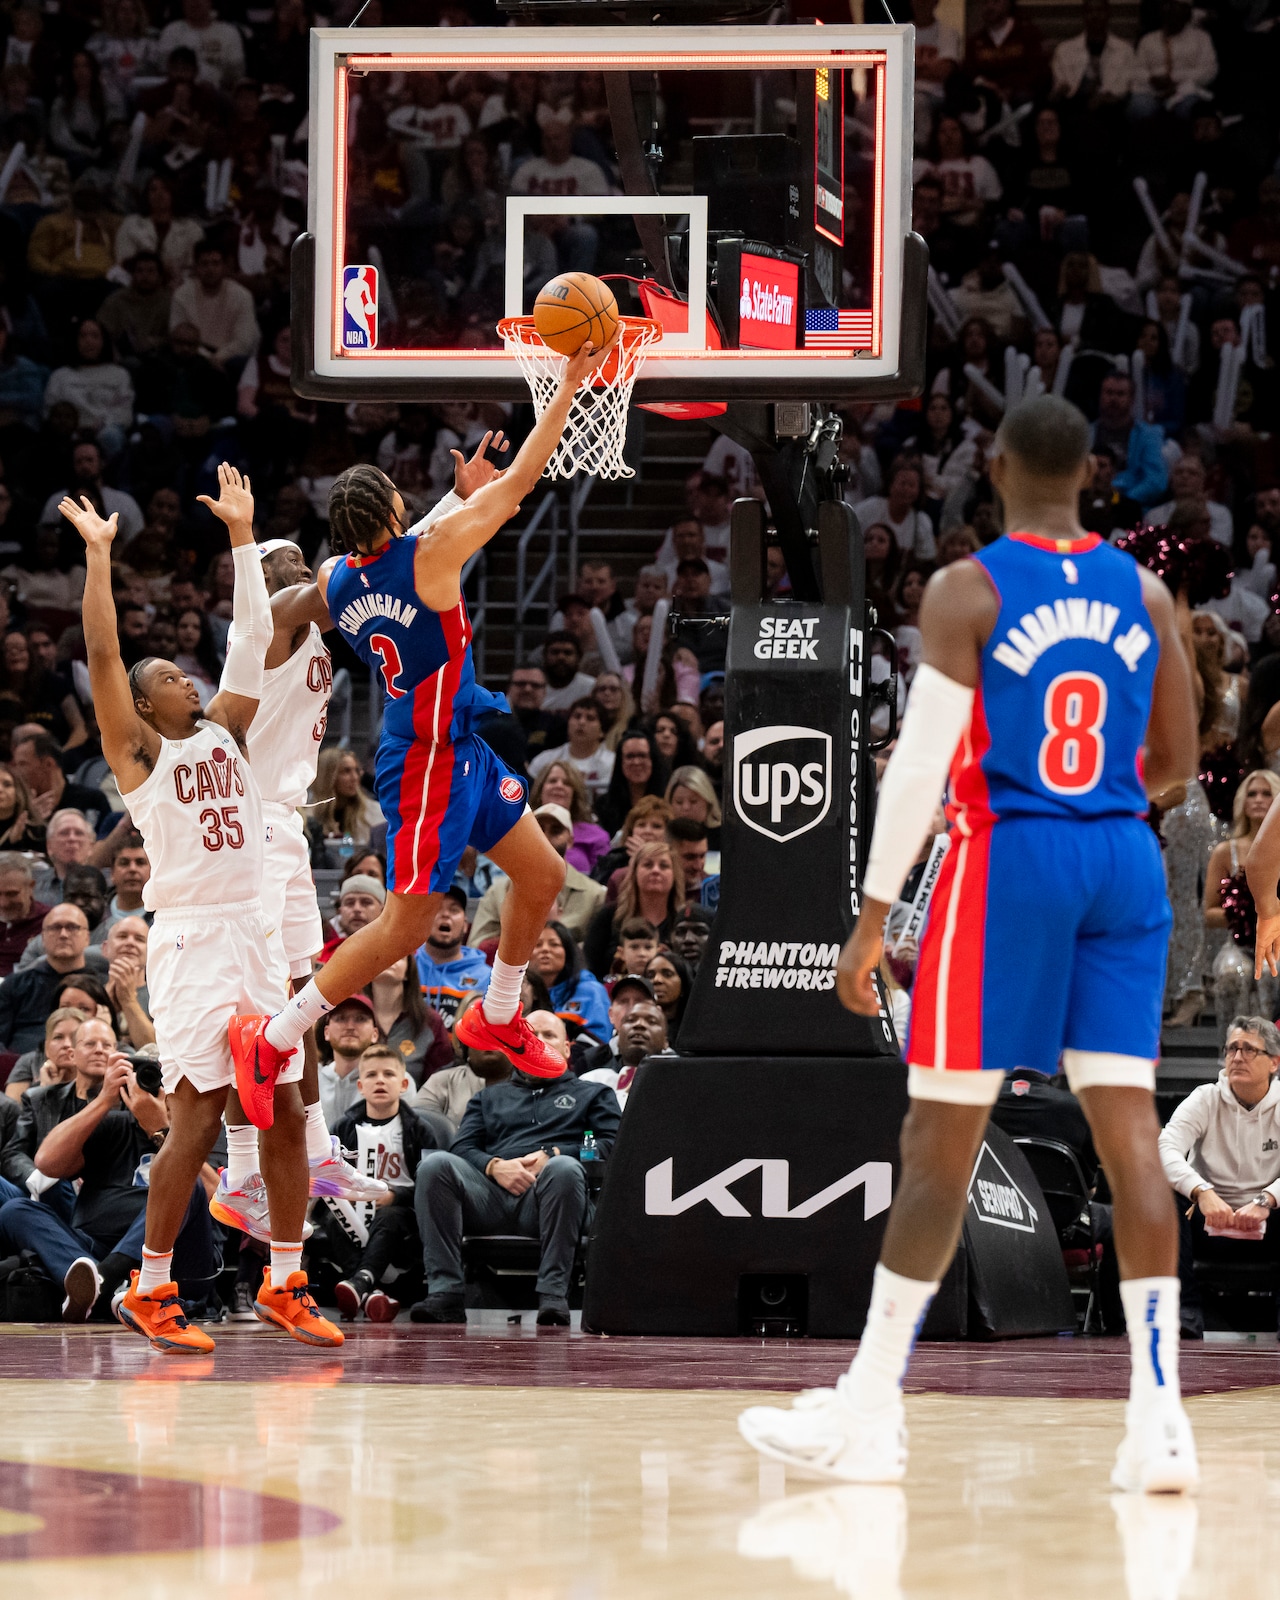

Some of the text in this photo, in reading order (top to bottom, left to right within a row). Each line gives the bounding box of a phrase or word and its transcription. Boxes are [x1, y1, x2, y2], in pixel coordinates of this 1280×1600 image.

[346, 330, 364, 345] NBA
[338, 593, 418, 636] CUNNINGHAM
[759, 617, 820, 639] SEAT
[992, 597, 1121, 677] HARDAWAY
[369, 633, 408, 700] 2
[753, 639, 820, 661] GEEK
[1037, 670, 1109, 797] 8
[173, 756, 245, 804] CAVS
[741, 762, 825, 824] ups
[199, 805, 245, 852] 35
[849, 708, 861, 917] Cleveland
[916, 892, 929, 912] EM
[924, 846, 946, 890] KNOW
[718, 940, 842, 968] PHANTOM
[714, 967, 839, 992] FIREWORKS
[645, 1156, 893, 1222] KIA
[977, 1178, 1024, 1221] SERVPRO
